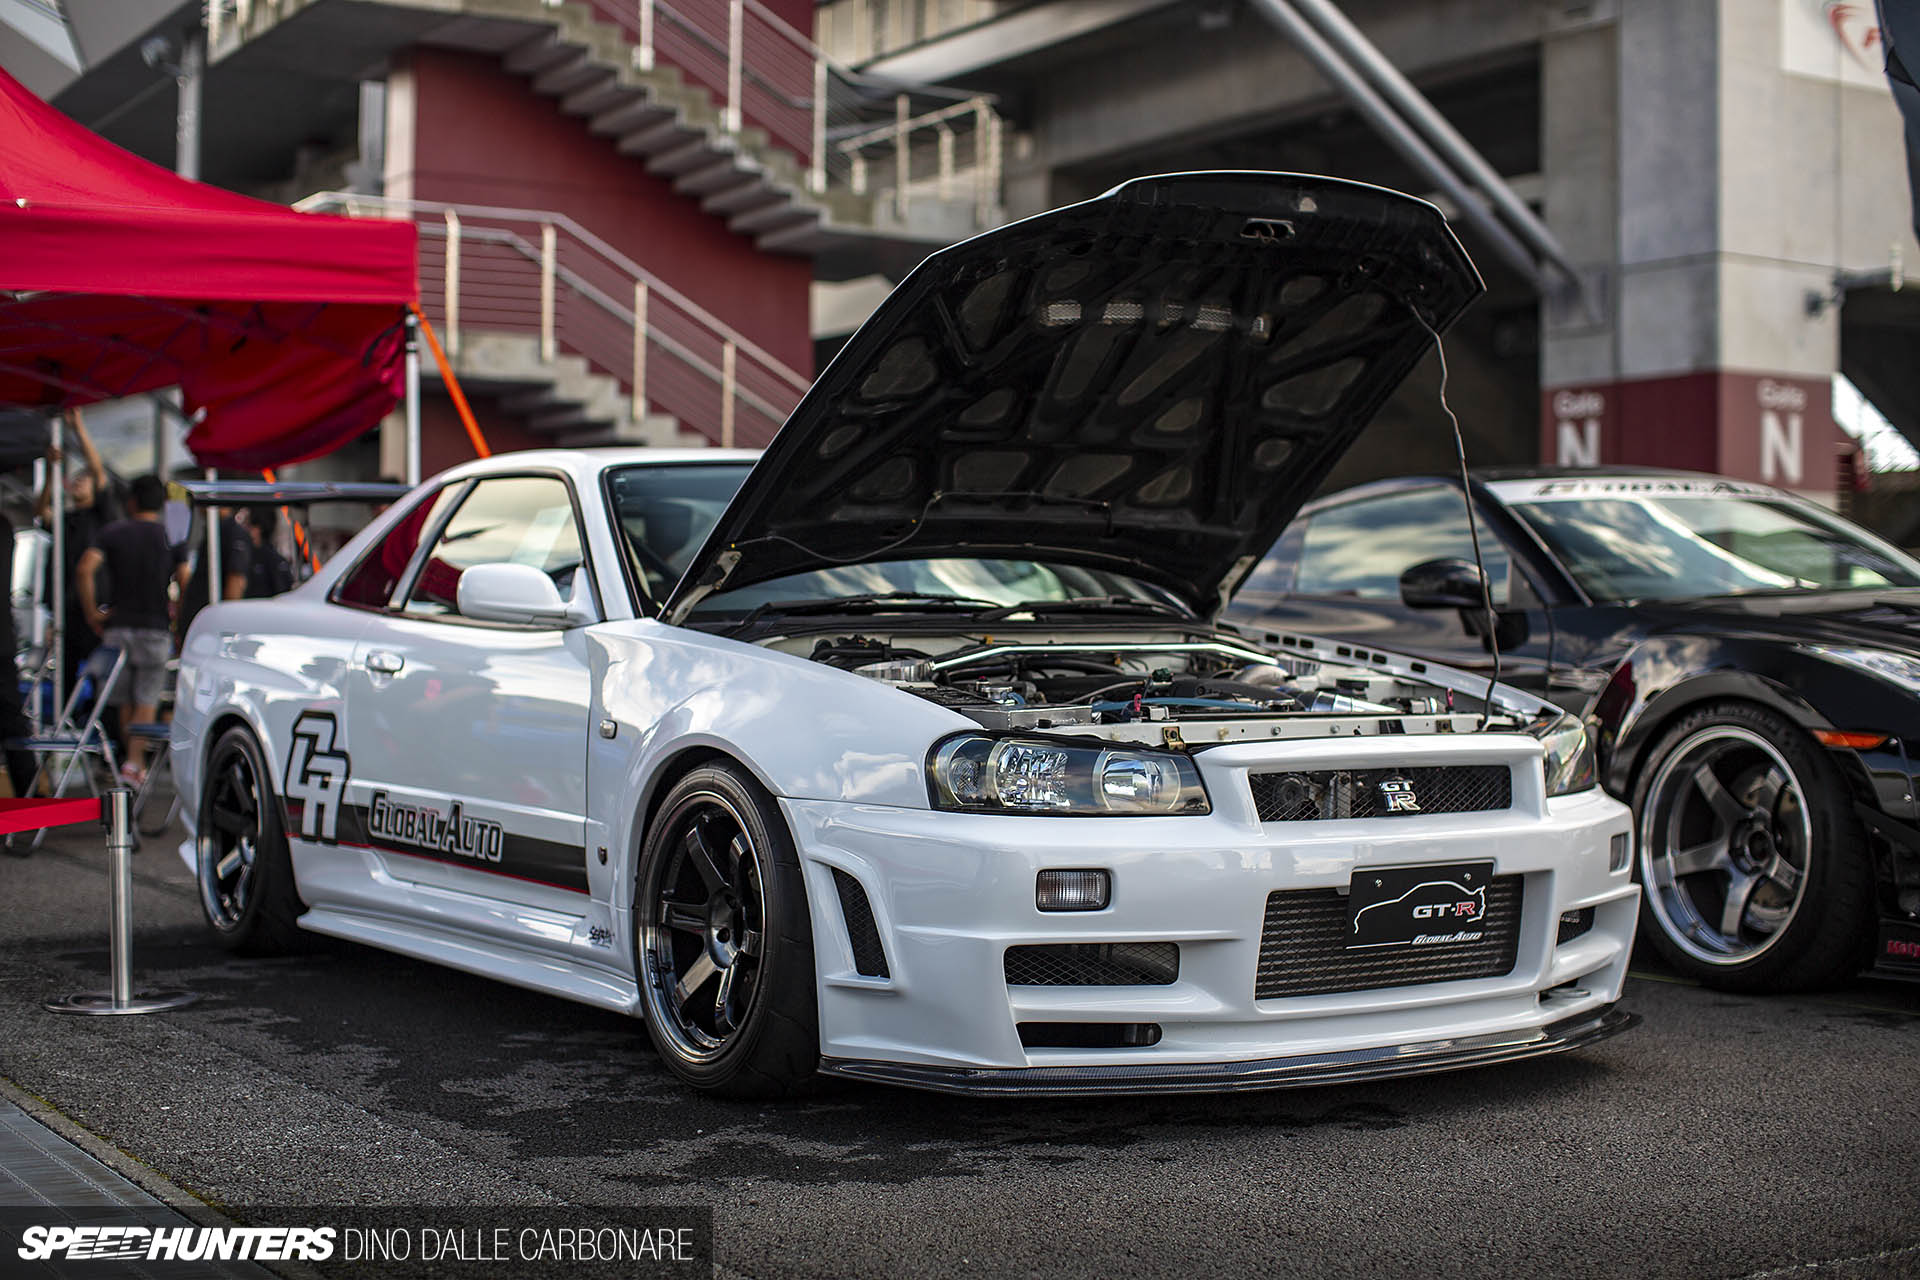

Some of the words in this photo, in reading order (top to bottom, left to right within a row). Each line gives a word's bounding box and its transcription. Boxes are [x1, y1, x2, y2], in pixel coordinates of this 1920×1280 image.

[1557, 419, 1600, 466] N
[1761, 411, 1803, 483] N
[1384, 791, 1420, 812] R
